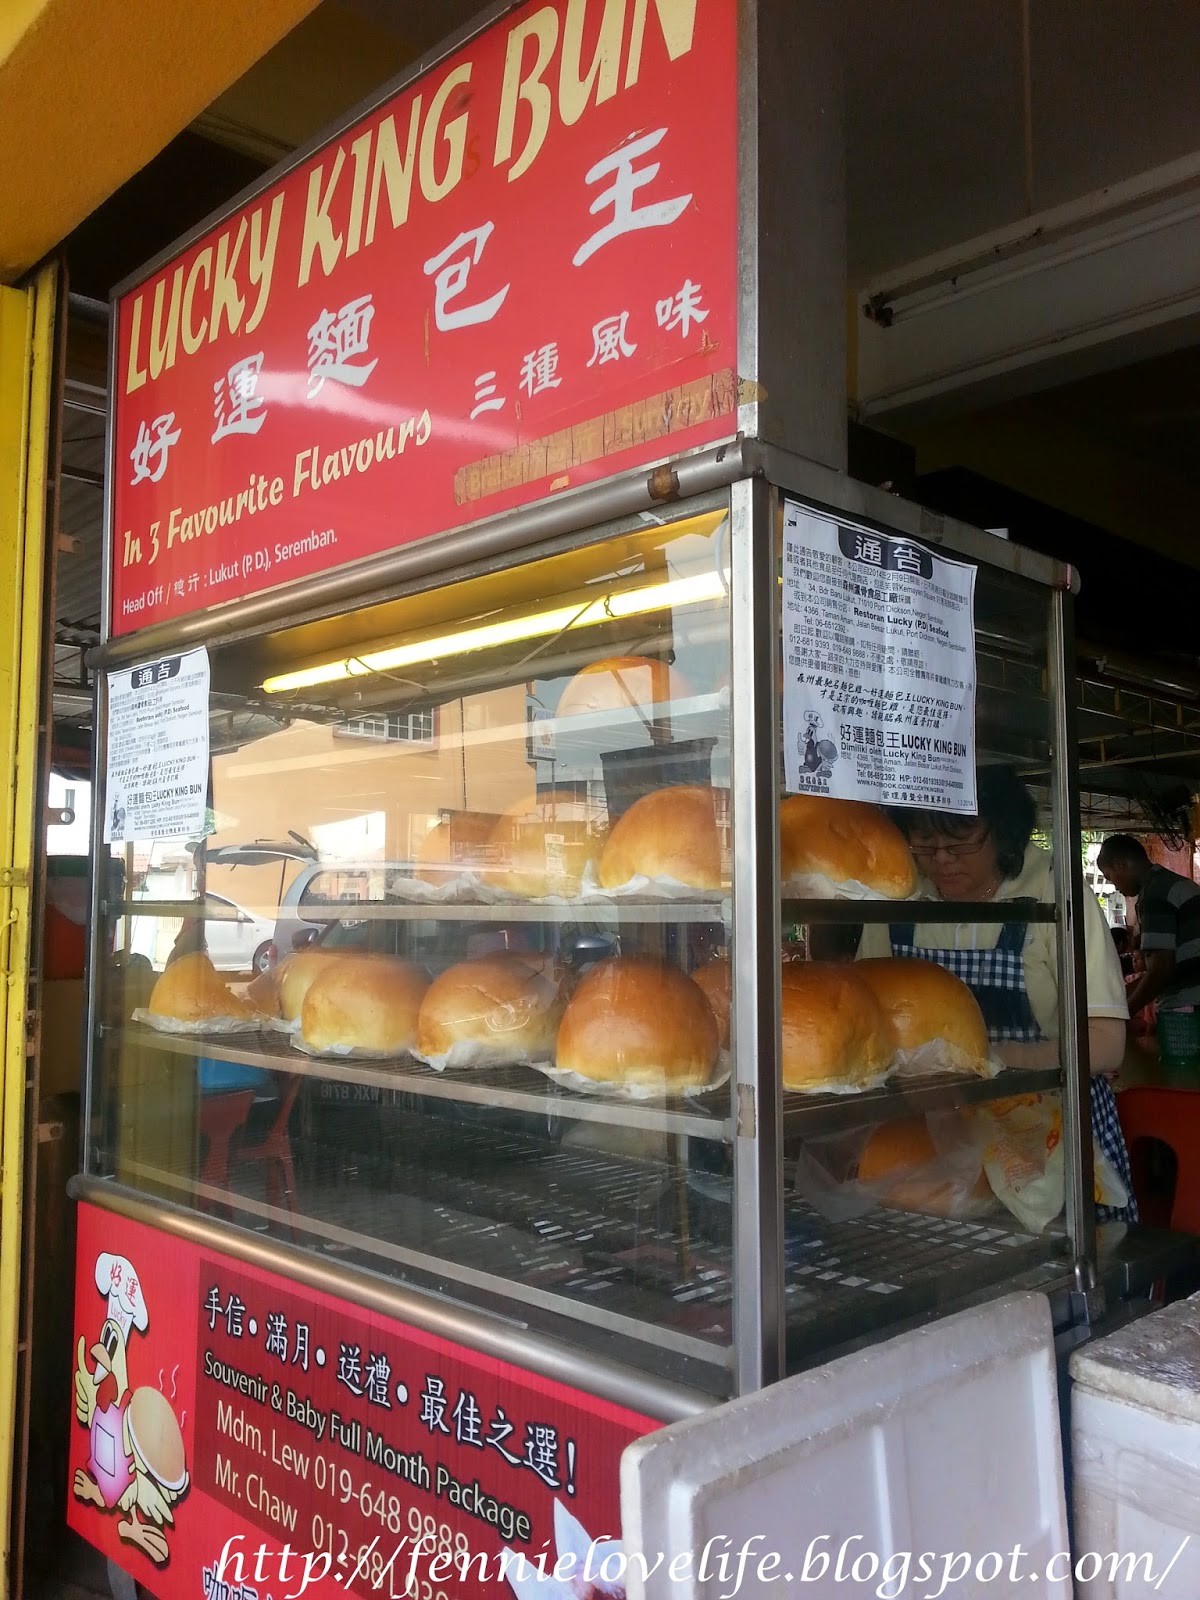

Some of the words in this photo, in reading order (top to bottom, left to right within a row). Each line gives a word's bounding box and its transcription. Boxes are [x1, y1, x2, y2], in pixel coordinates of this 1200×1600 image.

[127, 192, 284, 395] LUCKY
[298, 62, 472, 290] KING
[470, 278, 711, 421] 三種風味
[123, 530, 143, 568] In
[148, 520, 161, 566] 3
[167, 474, 284, 550] Favourite
[292, 409, 433, 499] Flavours
[123, 593, 146, 616] Head
[147, 586, 164, 607] Off
[209, 560, 239, 586] Lukut
[275, 528, 338, 564] Seremban.
[854, 535, 922, 574] 通告
[821, 608, 841, 622] Taman
[905, 627, 918, 639] Port
[853, 606, 884, 623] Restoran
[886, 612, 913, 630] Lucky
[914, 618, 928, 632] (P.D)
[928, 622, 949, 638] Seafood
[138, 660, 170, 687] 通告
[172, 702, 190, 714] Seafood
[911, 693, 935, 706] LUCKY
[935, 698, 949, 709] KING
[839, 721, 900, 750] 好運麵包王
[901, 732, 932, 752] LUCKY
[933, 738, 952, 755] KING
[953, 741, 967, 758] BUN
[882, 746, 909, 761] Lucky
[910, 750, 926, 763] King
[927, 753, 940, 763] Bun
[156, 786, 174, 800] LUCKY
[174, 784, 188, 797] KING
[188, 782, 202, 795] BUN
[856, 768, 866, 778] Tel:
[204, 1350, 269, 1405] Souvenir
[271, 1384, 284, 1411] &
[286, 1391, 327, 1440] Baby
[331, 1413, 361, 1453] Full
[366, 1431, 431, 1489] Month
[436, 1466, 531, 1543] Package
[217, 1400, 266, 1457] Mdm.
[272, 1429, 310, 1480] Lew
[315, 1455, 400, 1534] 019-648
[215, 1453, 241, 1498] Mr.
[246, 1474, 298, 1532] Chaw
